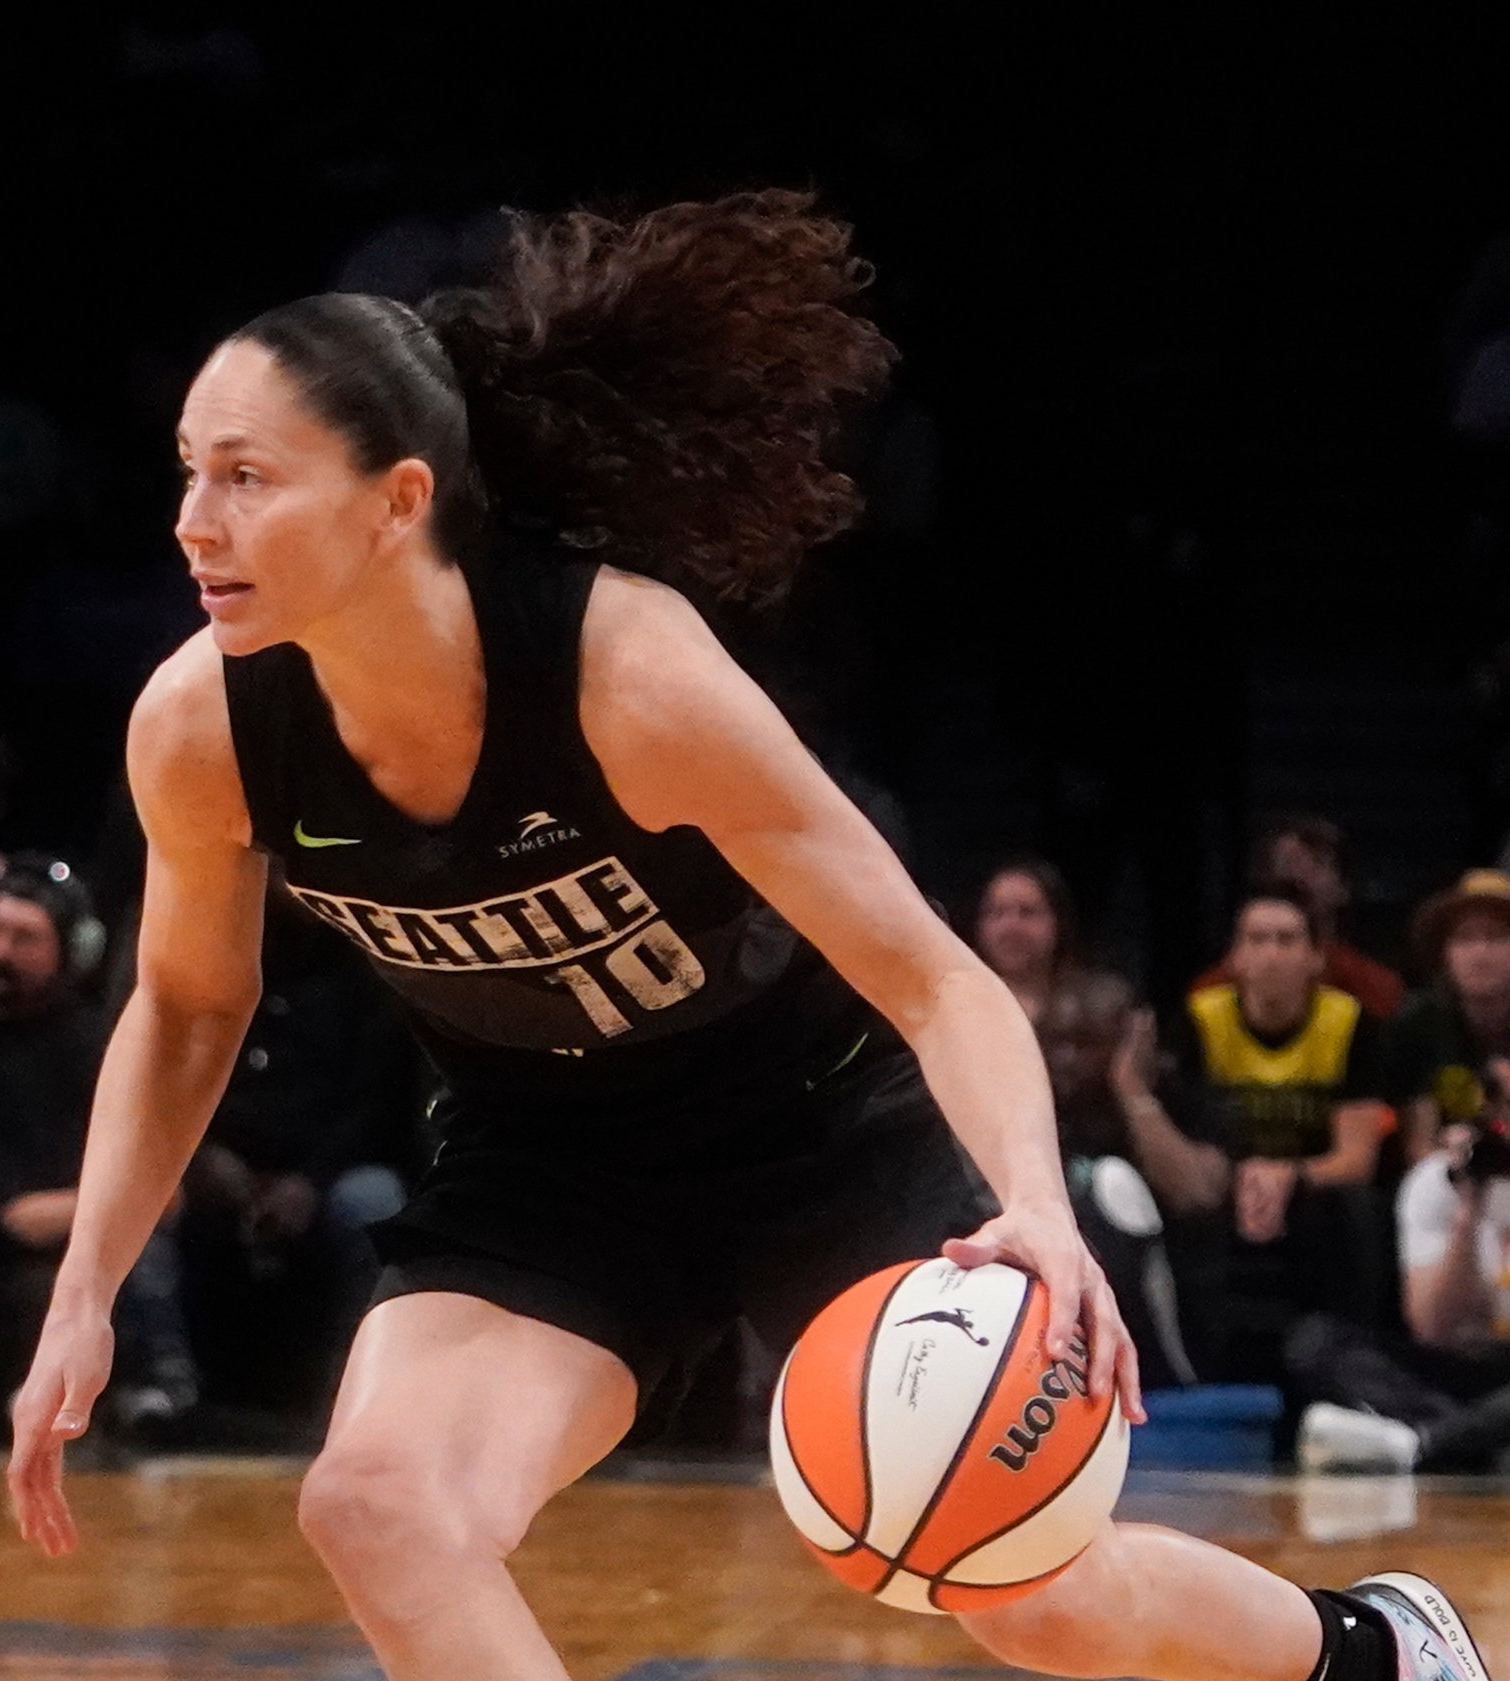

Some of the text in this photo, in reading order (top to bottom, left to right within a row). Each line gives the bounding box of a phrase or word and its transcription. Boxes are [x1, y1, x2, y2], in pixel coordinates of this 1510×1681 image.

[499, 828, 582, 858] SYMETRA
[292, 860, 655, 968] SEATTLE
[544, 919, 706, 1039] 10
[1424, 1595, 1450, 1626] BOLD
